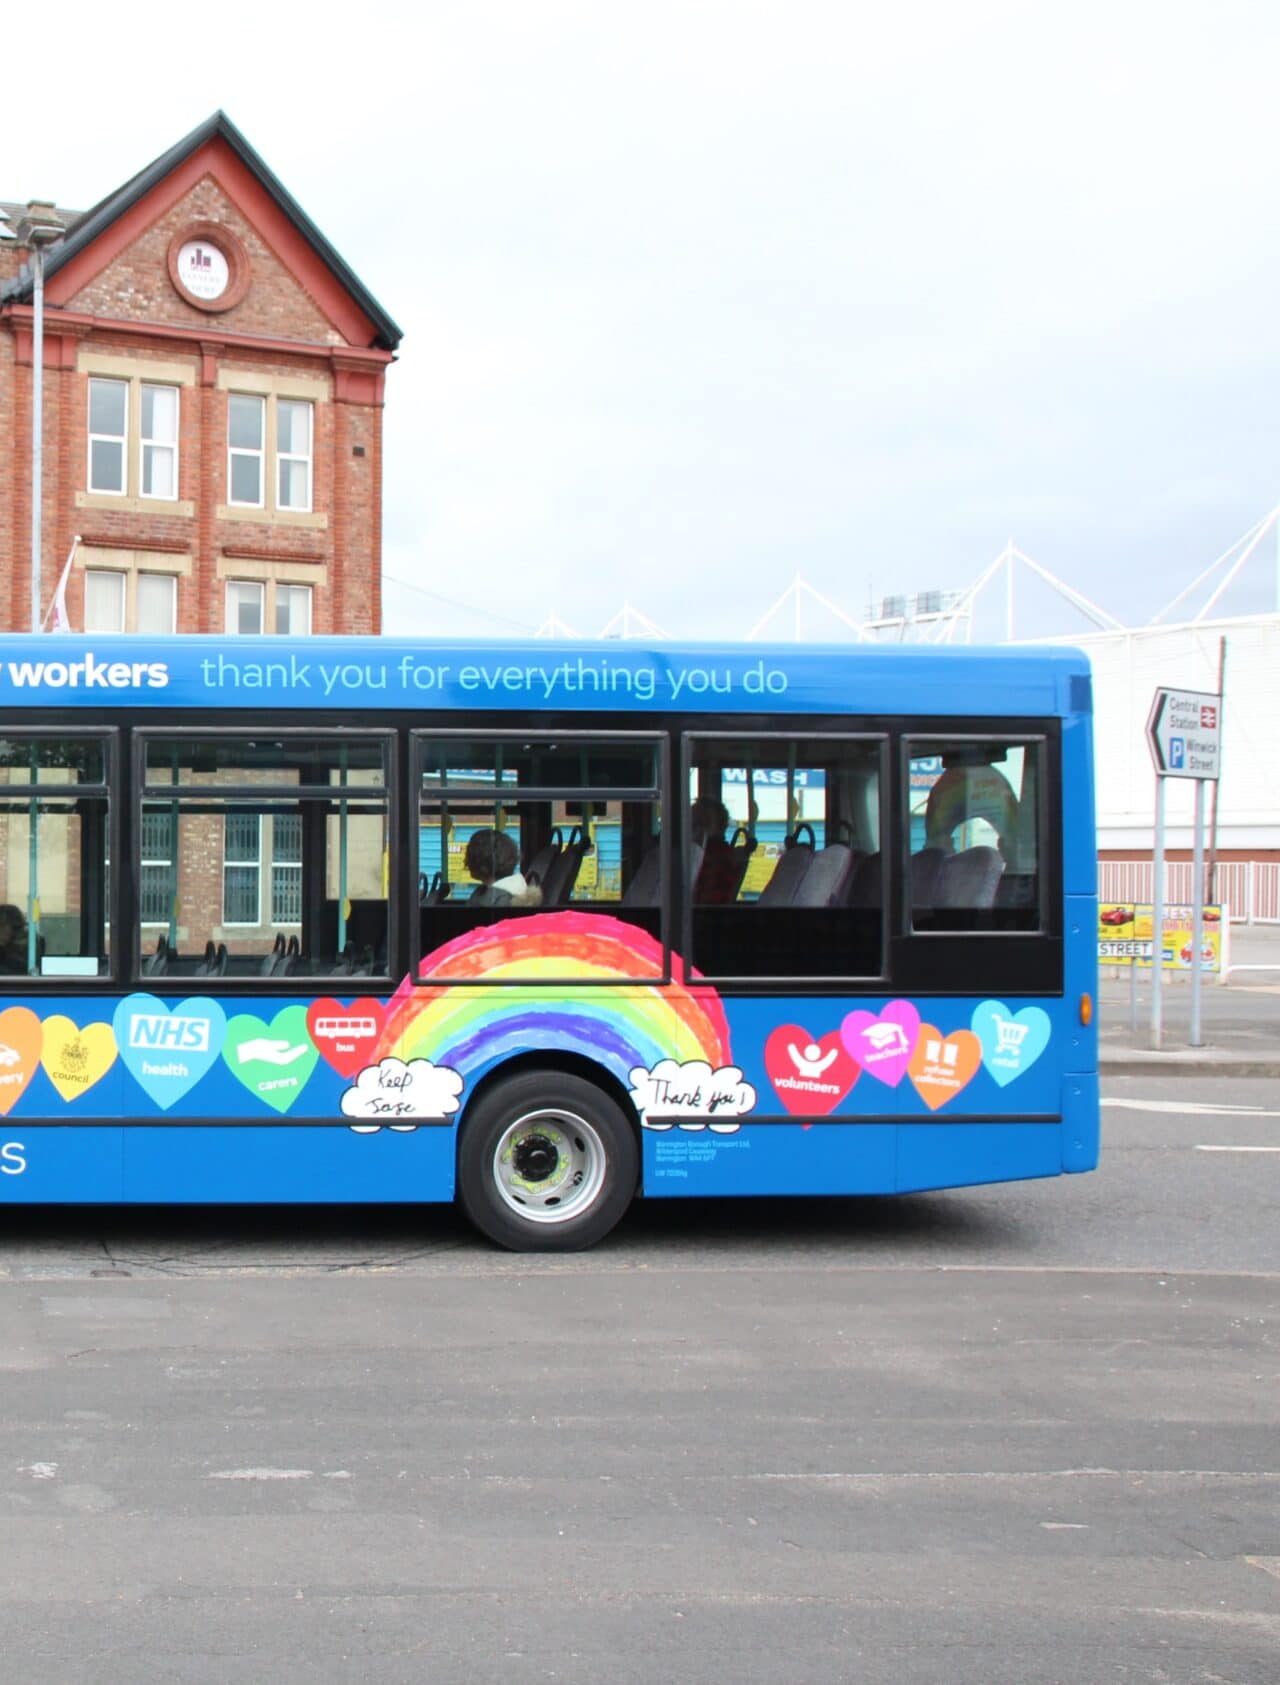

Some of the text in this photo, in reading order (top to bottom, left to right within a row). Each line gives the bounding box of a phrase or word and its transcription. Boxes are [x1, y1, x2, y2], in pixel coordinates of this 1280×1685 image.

[8, 652, 169, 688] workers
[200, 654, 788, 701] thank you for everything you do
[1169, 697, 1199, 713] Central
[1169, 714, 1199, 730] Station
[1189, 755, 1214, 770] Street
[1099, 942, 1149, 956] STREET
[132, 1018, 206, 1048] NHS
[336, 1042, 356, 1052] bus
[142, 1061, 189, 1077] health
[52, 1071, 90, 1084] council
[258, 1077, 298, 1091] carers
[377, 1068, 414, 1093] Keep
[647, 1077, 703, 1108] Thank
[774, 1077, 840, 1095] volunteers
